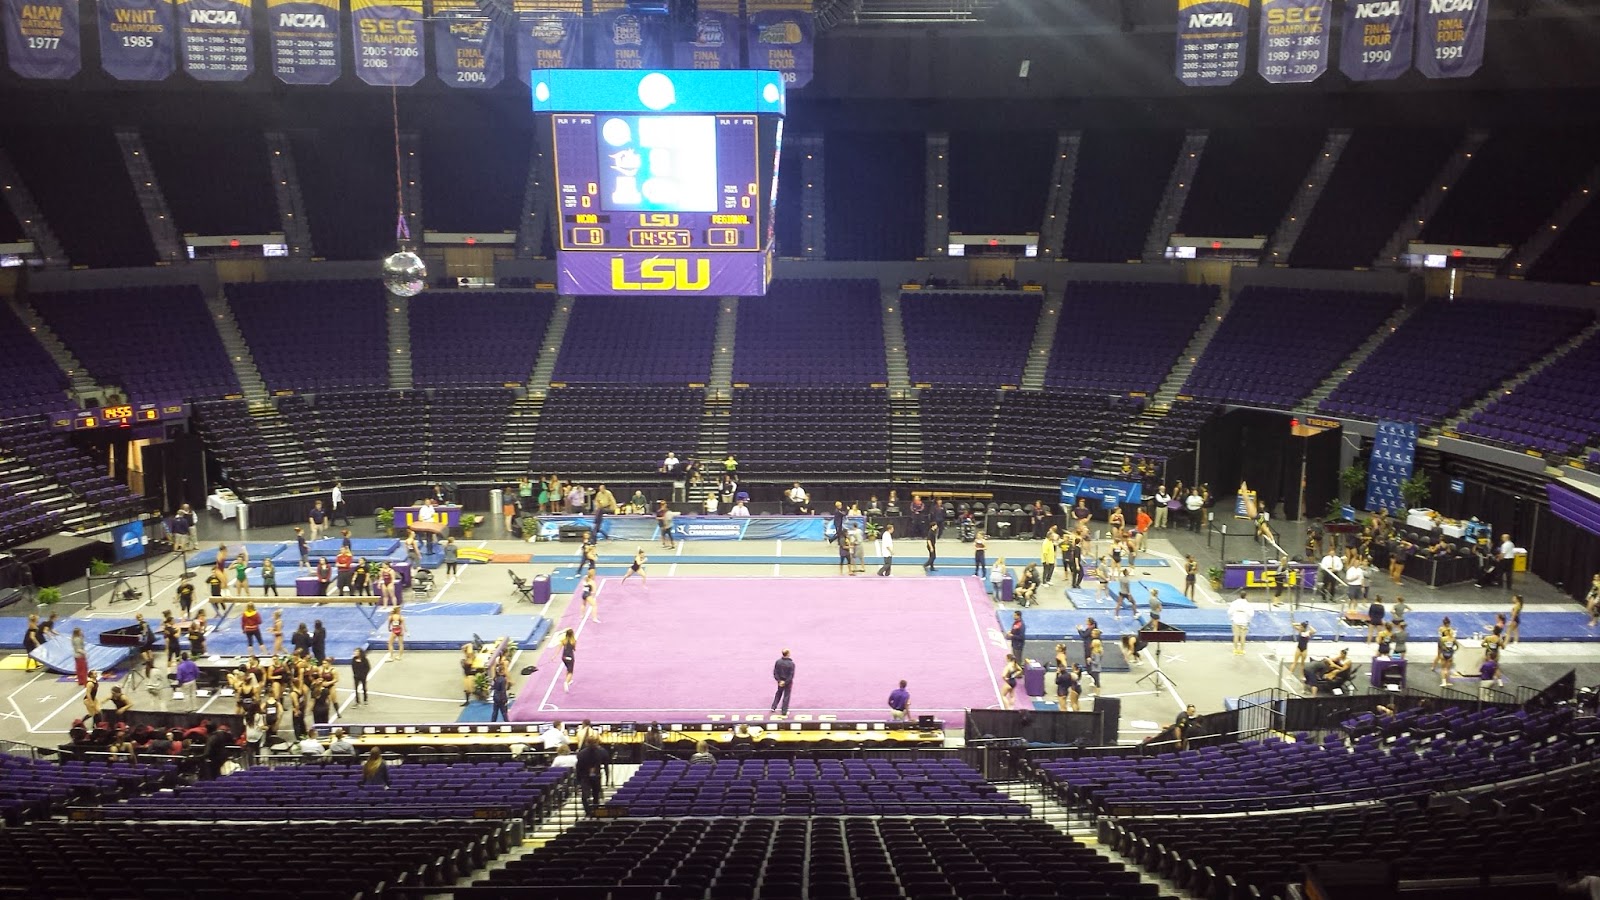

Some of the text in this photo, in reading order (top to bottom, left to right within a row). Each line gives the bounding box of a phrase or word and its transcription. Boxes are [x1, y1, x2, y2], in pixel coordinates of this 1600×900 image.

[1355, 1, 1400, 18] NCAA
[1429, 0, 1473, 14] NCAA
[115, 9, 156, 23] WNIT
[190, 9, 237, 24] NCAA
[279, 13, 326, 28] NCAA
[1188, 12, 1233, 28] NCAA
[1267, 6, 1322, 24] SEC
[360, 19, 415, 34] SEC
[1267, 23, 1323, 35] CHAMPIONS
[1364, 23, 1391, 34] FINAL
[1438, 19, 1464, 30] FINAL
[122, 36, 153, 47] 1985
[361, 34, 417, 44] CHAMPIONS
[1269, 35, 1320, 47] 1985 1986
[1363, 34, 1391, 46] FOUR
[1437, 30, 1464, 42] FOUR
[29, 37, 60, 49] 1977
[362, 47, 419, 57] 2005 2006
[457, 49, 484, 58] FINAL
[537, 50, 563, 59] FINAL
[615, 50, 641, 59] FINAL
[694, 51, 719, 60] FINAL
[769, 49, 794, 59] FINAL
[1268, 49, 1320, 61] 1989 1990
[1362, 50, 1391, 63] 1990
[1435, 46, 1463, 59] 1991
[363, 59, 388, 68] 2008
[457, 58, 485, 68] FOUR
[538, 60, 563, 69] FOUR
[616, 60, 642, 69] FOUR
[769, 59, 795, 69] FOUR
[1265, 64, 1318, 75] 1991 2009
[457, 71, 486, 82] 2004
[783, 72, 796, 83] 08
[640, 213, 679, 227] LSU
[589, 229, 601, 244] 0
[640, 231, 677, 246] 14:55
[725, 229, 735, 245] 0
[611, 257, 710, 291] LSU
[105, 406, 132, 419] 14:55
[163, 405, 181, 414] LSU
[1306, 417, 1340, 428] TIGERS
